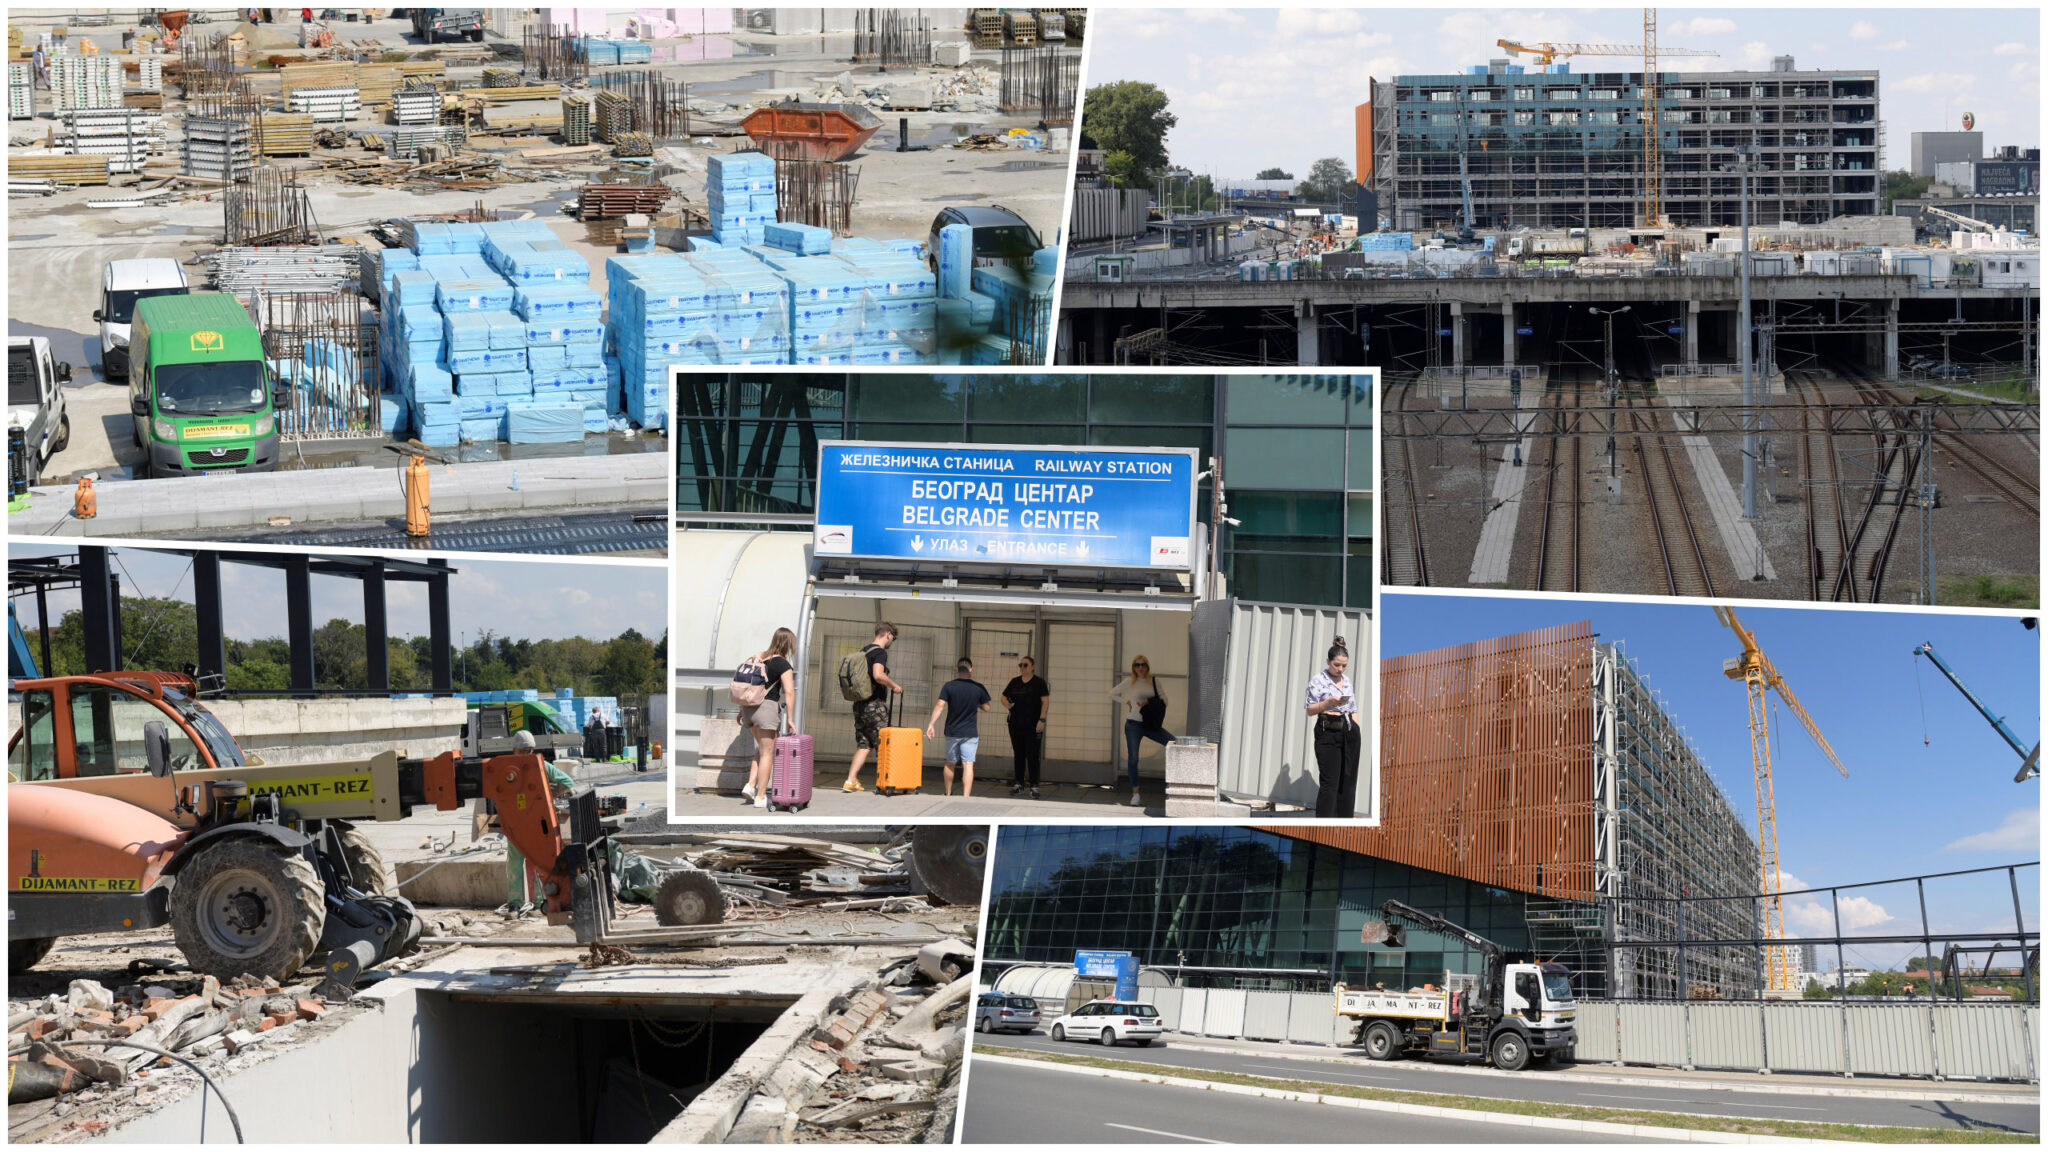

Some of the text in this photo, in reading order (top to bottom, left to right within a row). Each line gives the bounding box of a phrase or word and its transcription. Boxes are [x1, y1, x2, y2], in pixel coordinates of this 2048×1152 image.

[840, 453, 1015, 472] ЖЕЛЕЗНИЧКА СТАНИЦА
[1035, 459, 1172, 475] RAILWAY STATION
[912, 479, 1094, 506] БЕОГРАД ЦЕНТАР
[903, 505, 1100, 531] BELGRADE CENTER
[930, 538, 968, 552] УЛАЗ
[987, 540, 1067, 556] ENTRANCE
